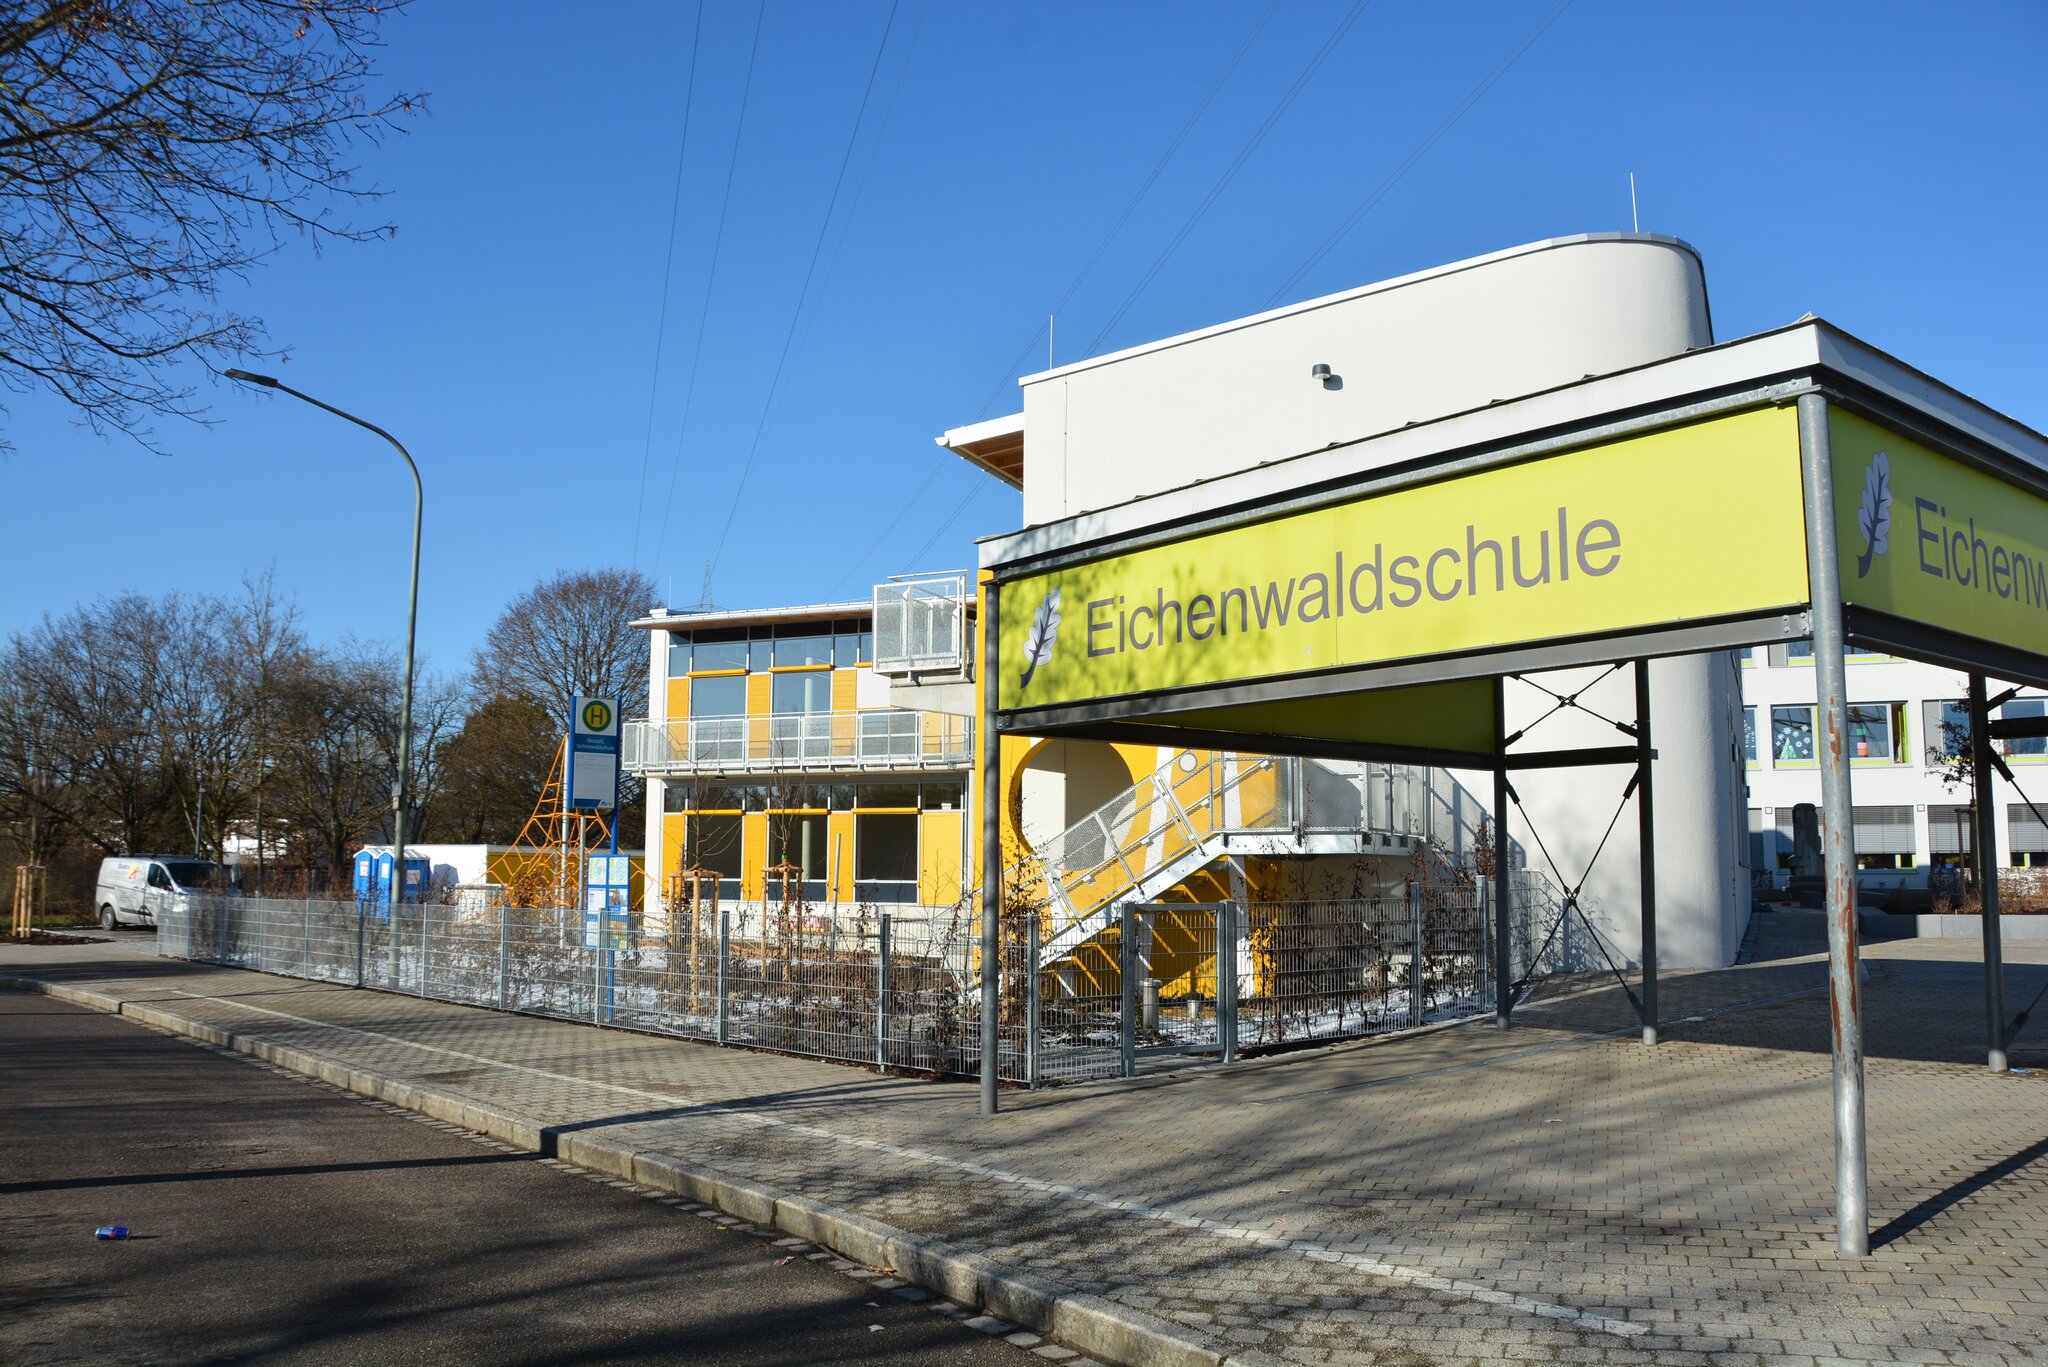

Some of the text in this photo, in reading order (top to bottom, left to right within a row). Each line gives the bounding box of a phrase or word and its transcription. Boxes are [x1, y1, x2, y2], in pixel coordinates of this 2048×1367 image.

[1086, 507, 1622, 658] Eichenwaldschule
[1915, 496, 2048, 611] Eichenw
[591, 707, 603, 725] H
